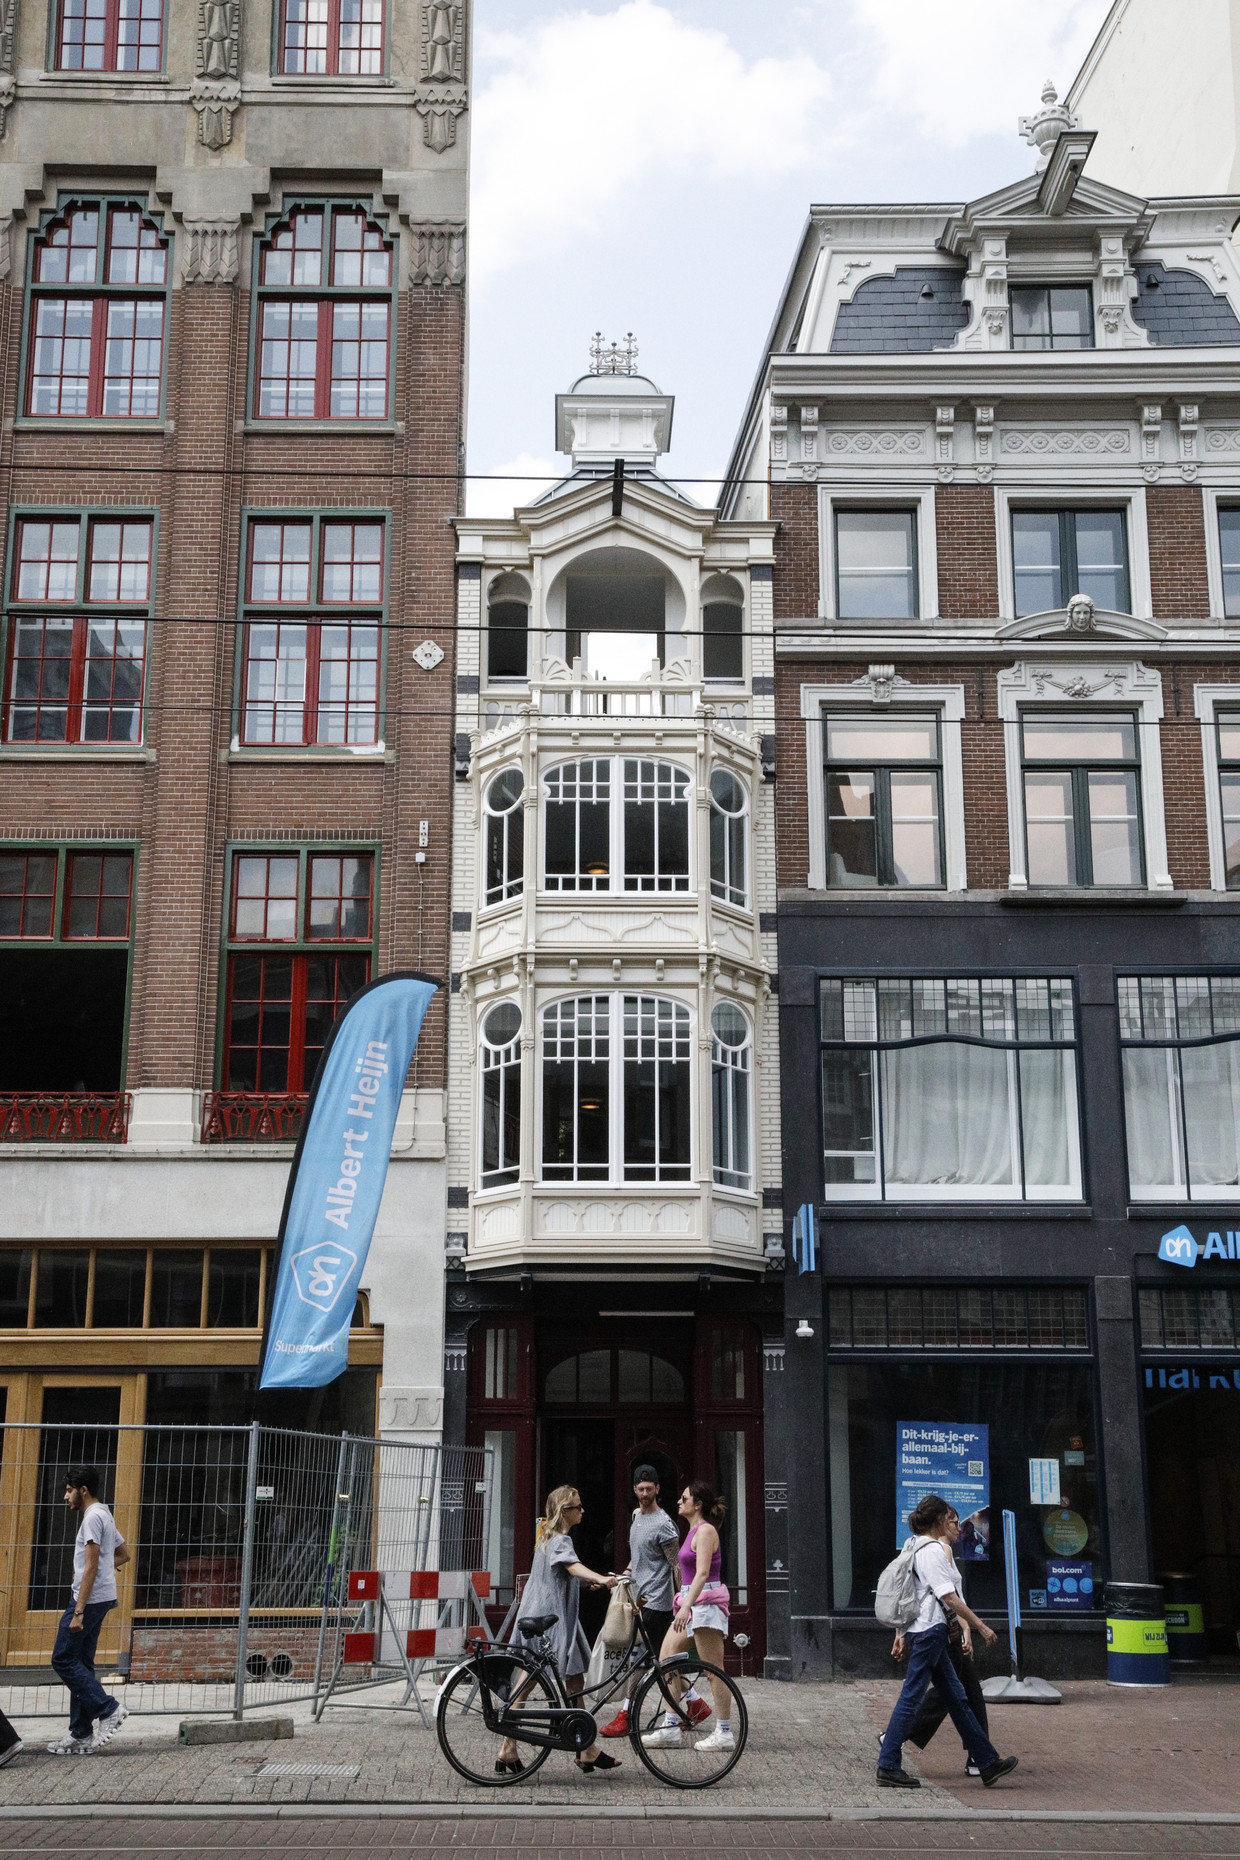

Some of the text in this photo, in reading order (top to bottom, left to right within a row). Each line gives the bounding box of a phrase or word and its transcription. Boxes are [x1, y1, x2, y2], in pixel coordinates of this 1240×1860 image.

[325, 1040, 389, 1231] Albert Heijn
[902, 1429, 979, 1443] Dit-krijg-je-er-
[902, 1441, 969, 1456] allemaal-bij-
[902, 1453, 931, 1465] baan.
[1052, 1566, 1083, 1574] bol.com
[610, 1663, 628, 1674] te
